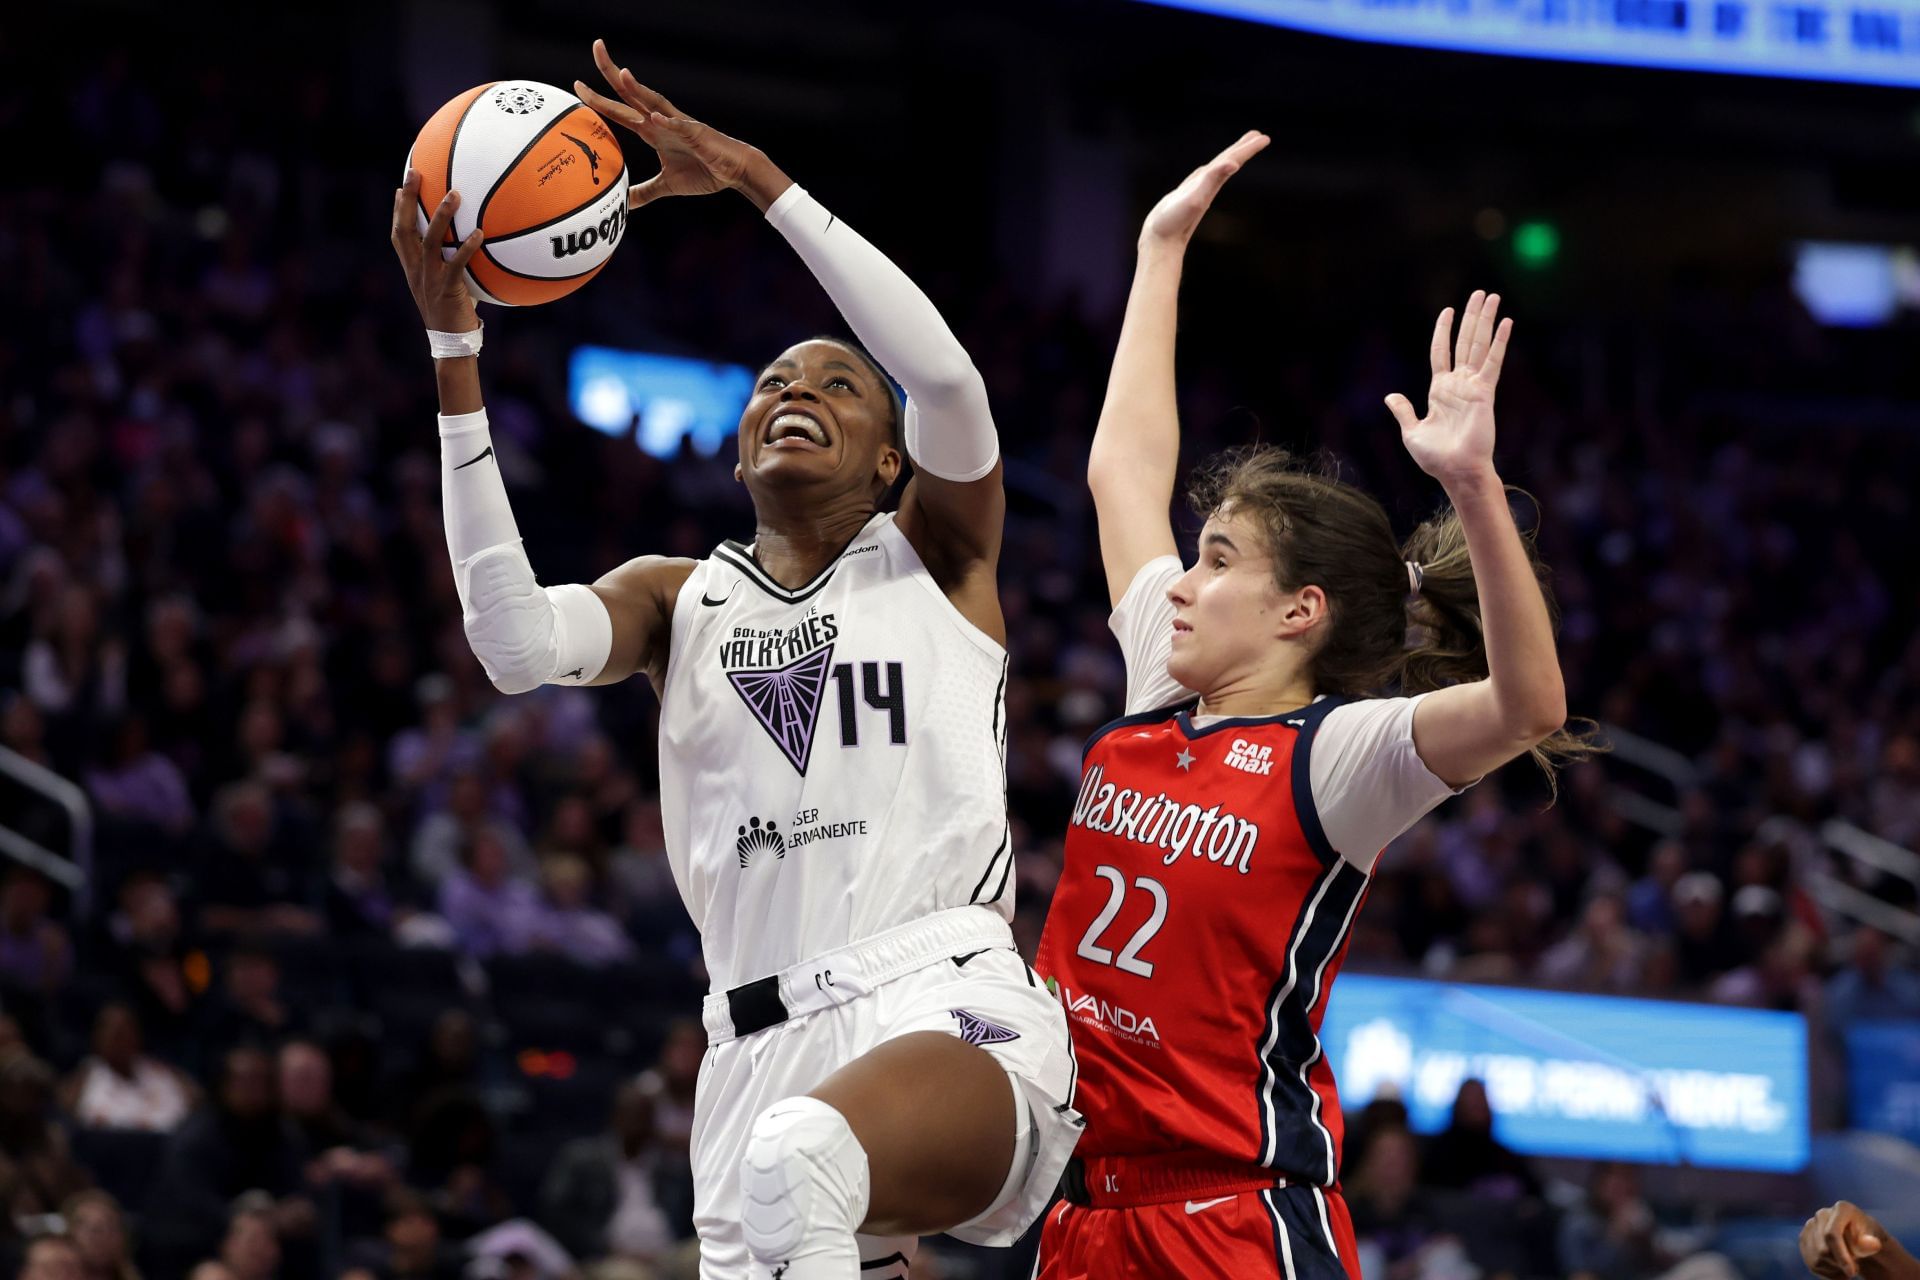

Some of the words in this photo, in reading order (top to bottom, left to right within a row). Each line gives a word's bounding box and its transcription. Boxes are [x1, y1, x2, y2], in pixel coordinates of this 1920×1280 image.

[550, 200, 627, 259] ilson
[719, 613, 839, 669] VALKYRIES
[733, 627, 783, 639] GOLDEN
[829, 661, 908, 748] 14
[1223, 750, 1274, 776] max
[1231, 738, 1273, 761] CAR
[788, 820, 867, 848] ERMANENTE
[793, 808, 819, 826] SER
[1072, 763, 1258, 875] Washington
[1077, 865, 1169, 979] 22
[1065, 988, 1160, 1041] VANDA
